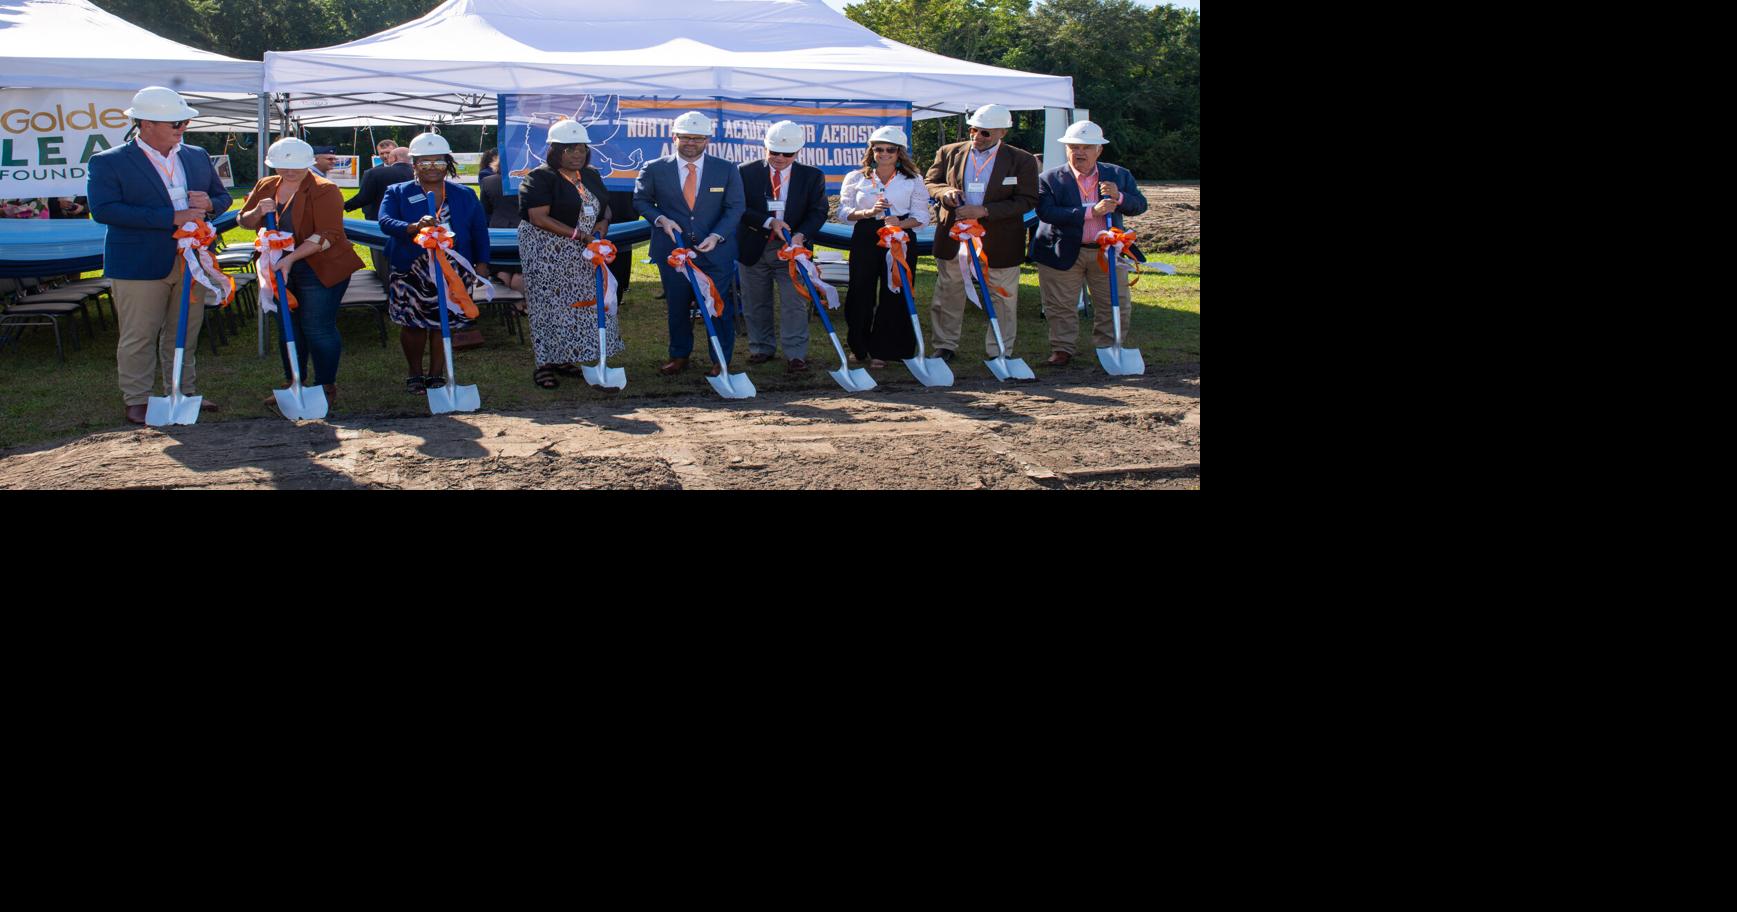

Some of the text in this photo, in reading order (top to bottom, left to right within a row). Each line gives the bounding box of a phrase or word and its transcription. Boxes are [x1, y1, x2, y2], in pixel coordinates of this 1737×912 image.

[1, 103, 128, 134] Golde
[724, 119, 770, 140] ACADE
[821, 124, 903, 144] AEROSP
[1, 133, 112, 166] LEA
[704, 142, 866, 167] DVANCED HNOLOGIE
[0, 167, 86, 181] FOUND
